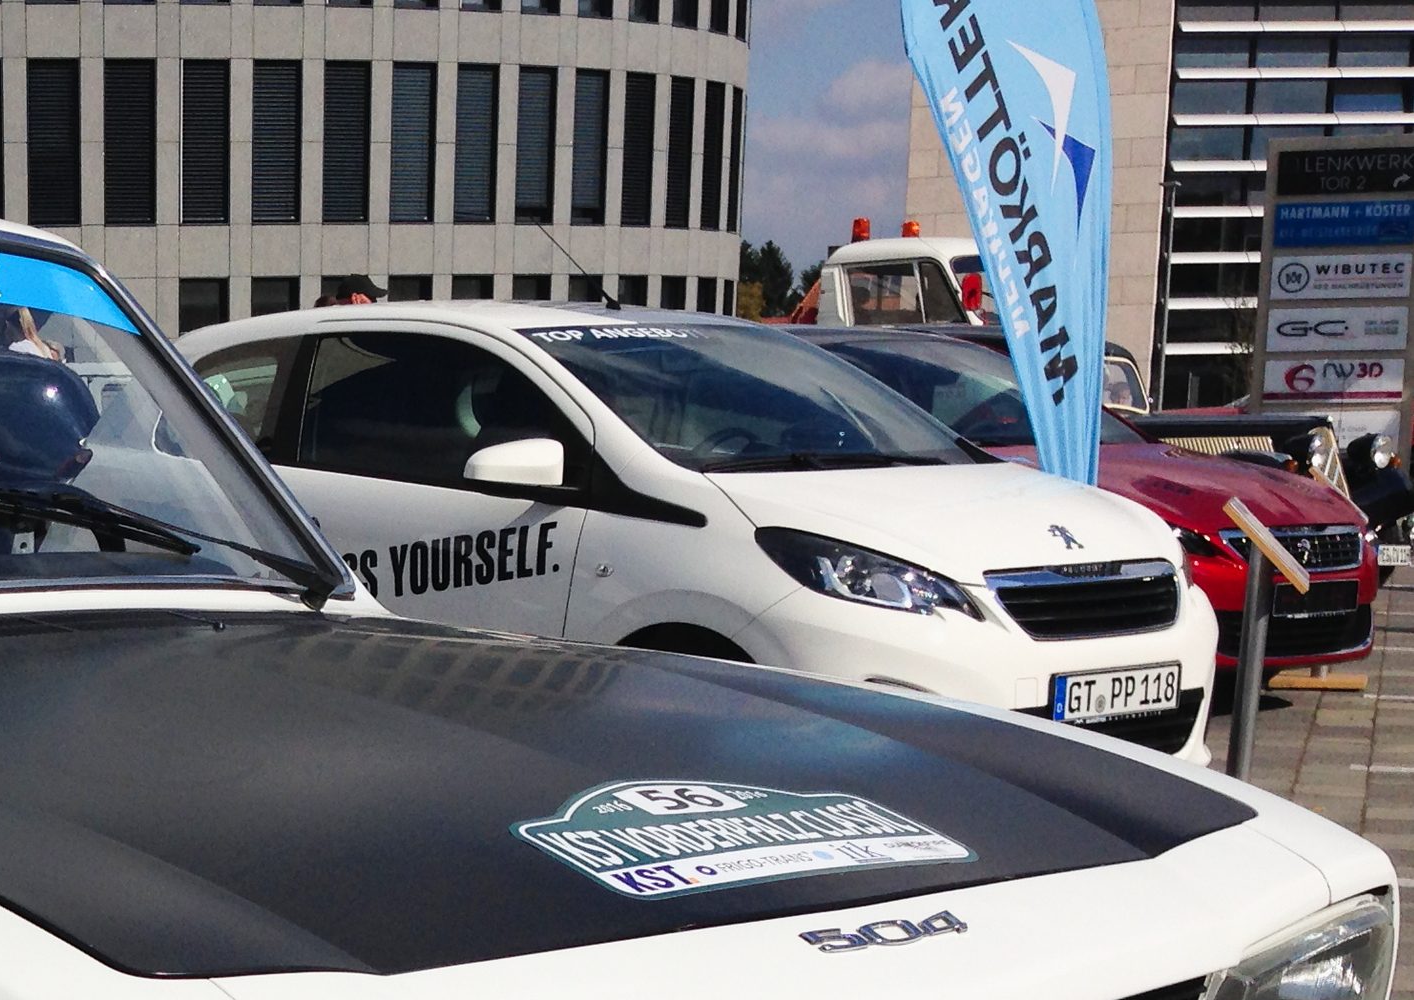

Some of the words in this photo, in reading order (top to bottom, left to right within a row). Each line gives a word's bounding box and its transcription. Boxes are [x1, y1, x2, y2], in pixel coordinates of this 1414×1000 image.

[1305, 153, 1414, 172] LENKWERK
[1320, 176, 1351, 190] TOR
[1357, 176, 1367, 190] 2
[1280, 207, 1349, 219] HARTMANN
[1316, 262, 1405, 275] WIBUTEC
[531, 329, 586, 343] TOP
[389, 521, 559, 597] YOURSELF.
[1068, 680, 1096, 713] GT
[1111, 676, 1136, 709] PP
[1139, 671, 1176, 705] 118
[592, 800, 634, 814] 2016
[636, 788, 724, 811] 56
[538, 830, 625, 868] KST
[600, 813, 824, 862] VORDERPFALZ
[790, 800, 920, 838] CLASSIC
[797, 908, 969, 954] 504
